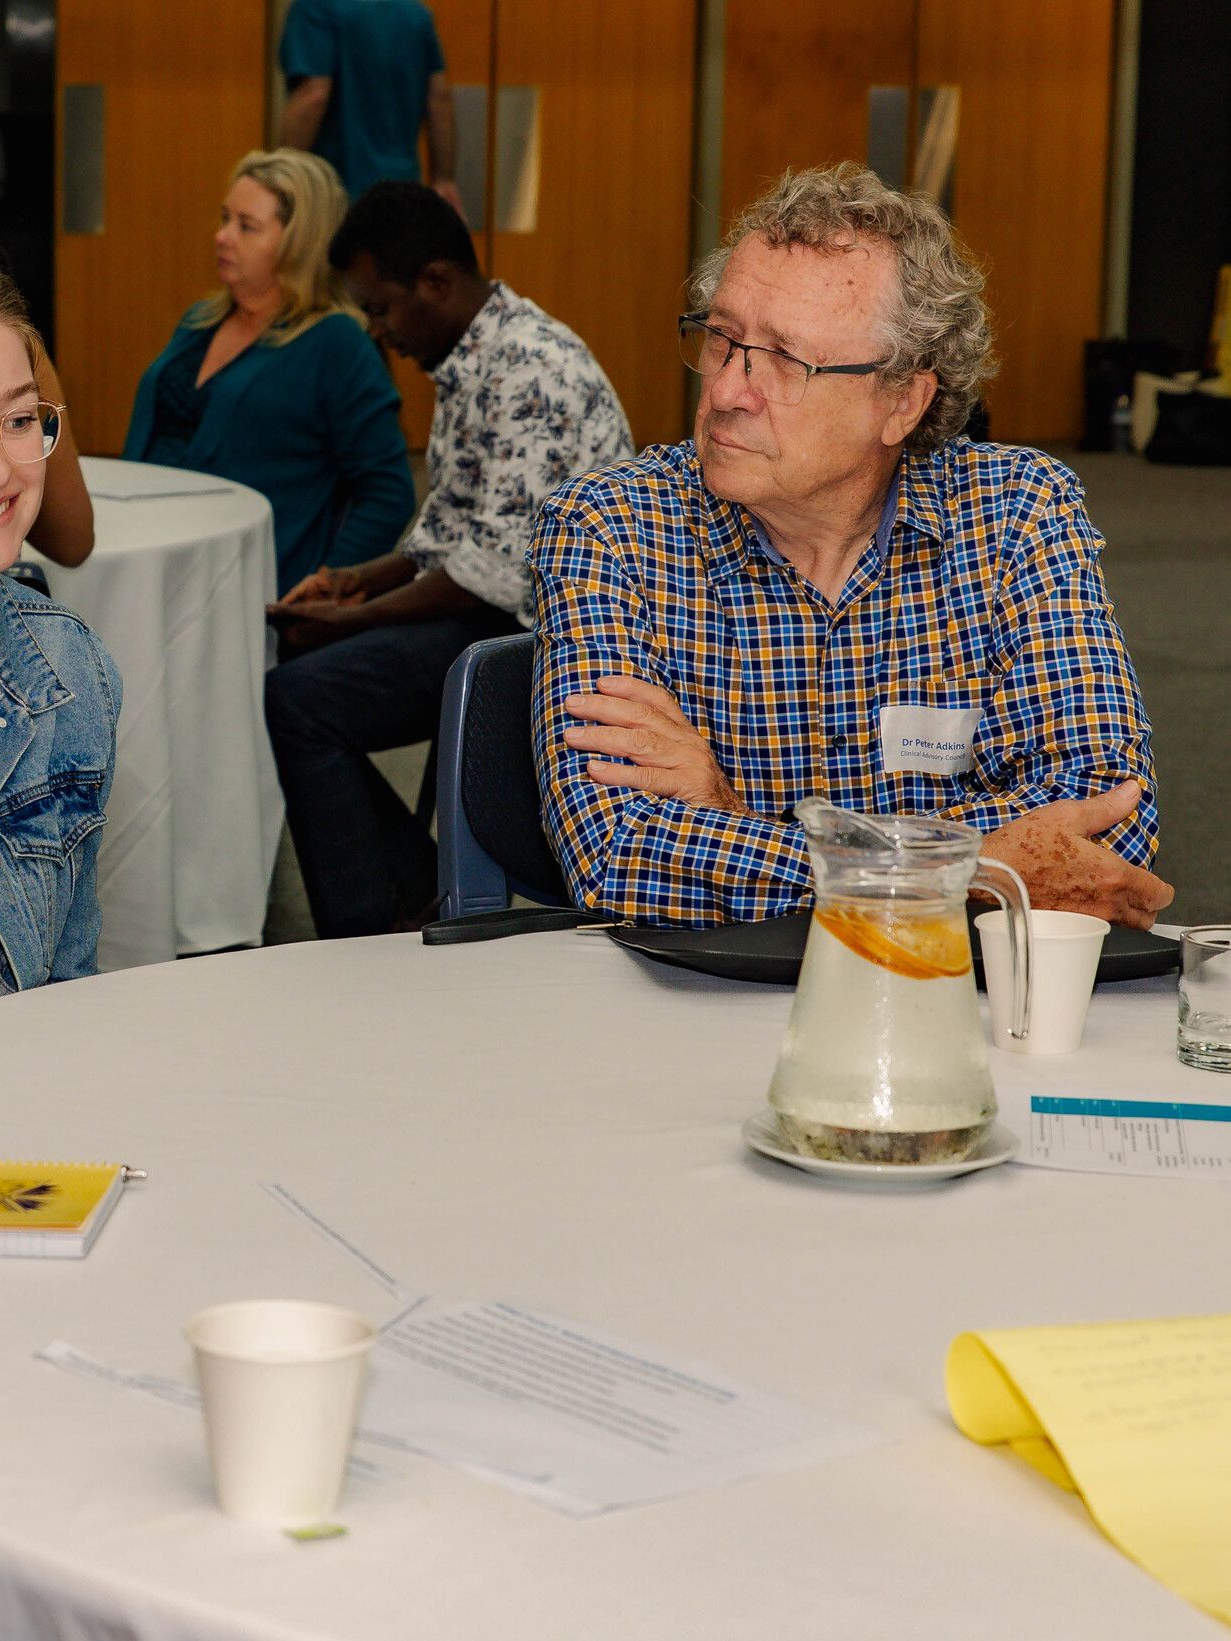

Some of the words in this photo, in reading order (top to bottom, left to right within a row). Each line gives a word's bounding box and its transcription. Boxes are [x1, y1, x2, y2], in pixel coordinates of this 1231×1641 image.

[902, 738, 913, 747] Dr
[915, 738, 934, 749] Peter
[936, 741, 965, 751] Adkins
